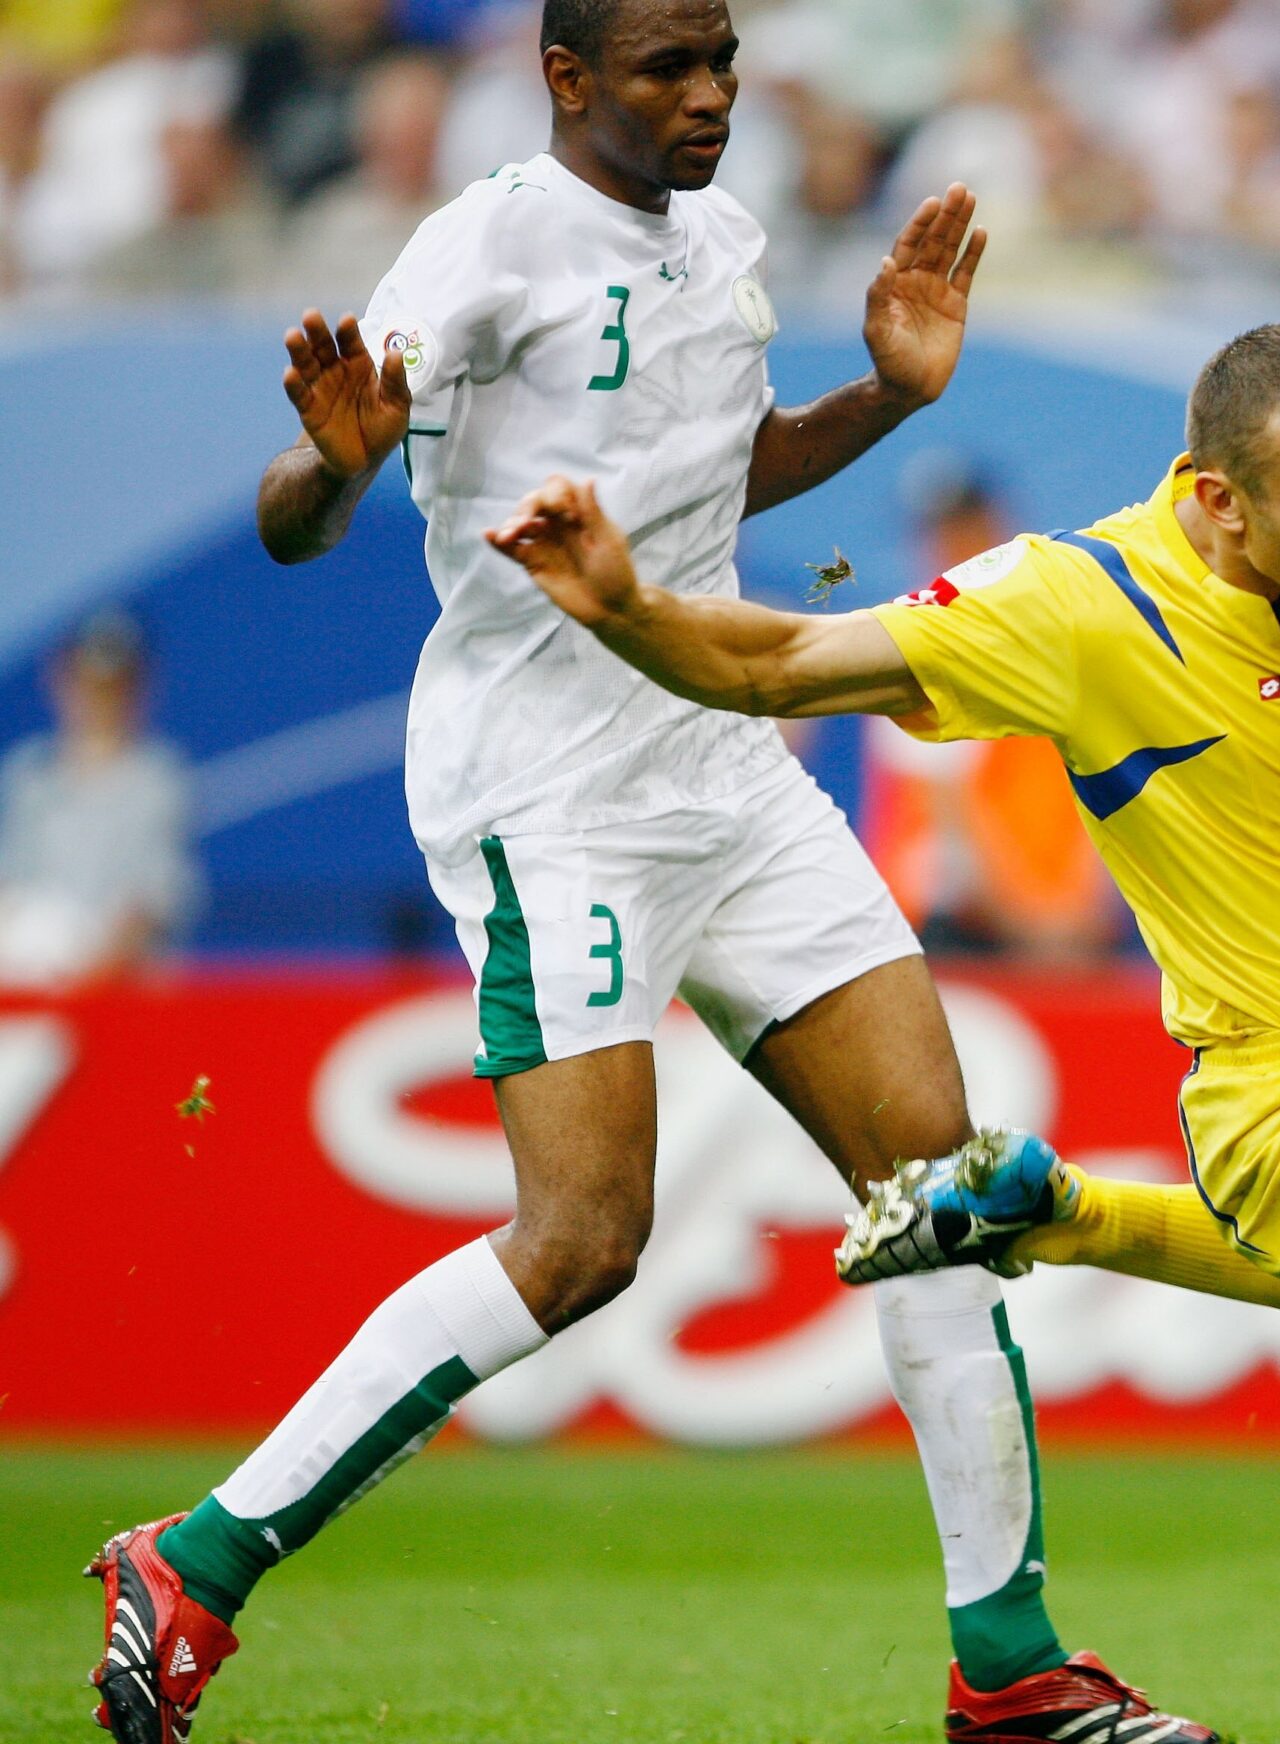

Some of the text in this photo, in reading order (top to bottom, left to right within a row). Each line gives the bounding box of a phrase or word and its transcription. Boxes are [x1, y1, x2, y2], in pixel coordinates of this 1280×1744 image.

[587, 285, 630, 391] 3
[586, 903, 624, 1008] 3
[168, 1636, 186, 1678] adidas
